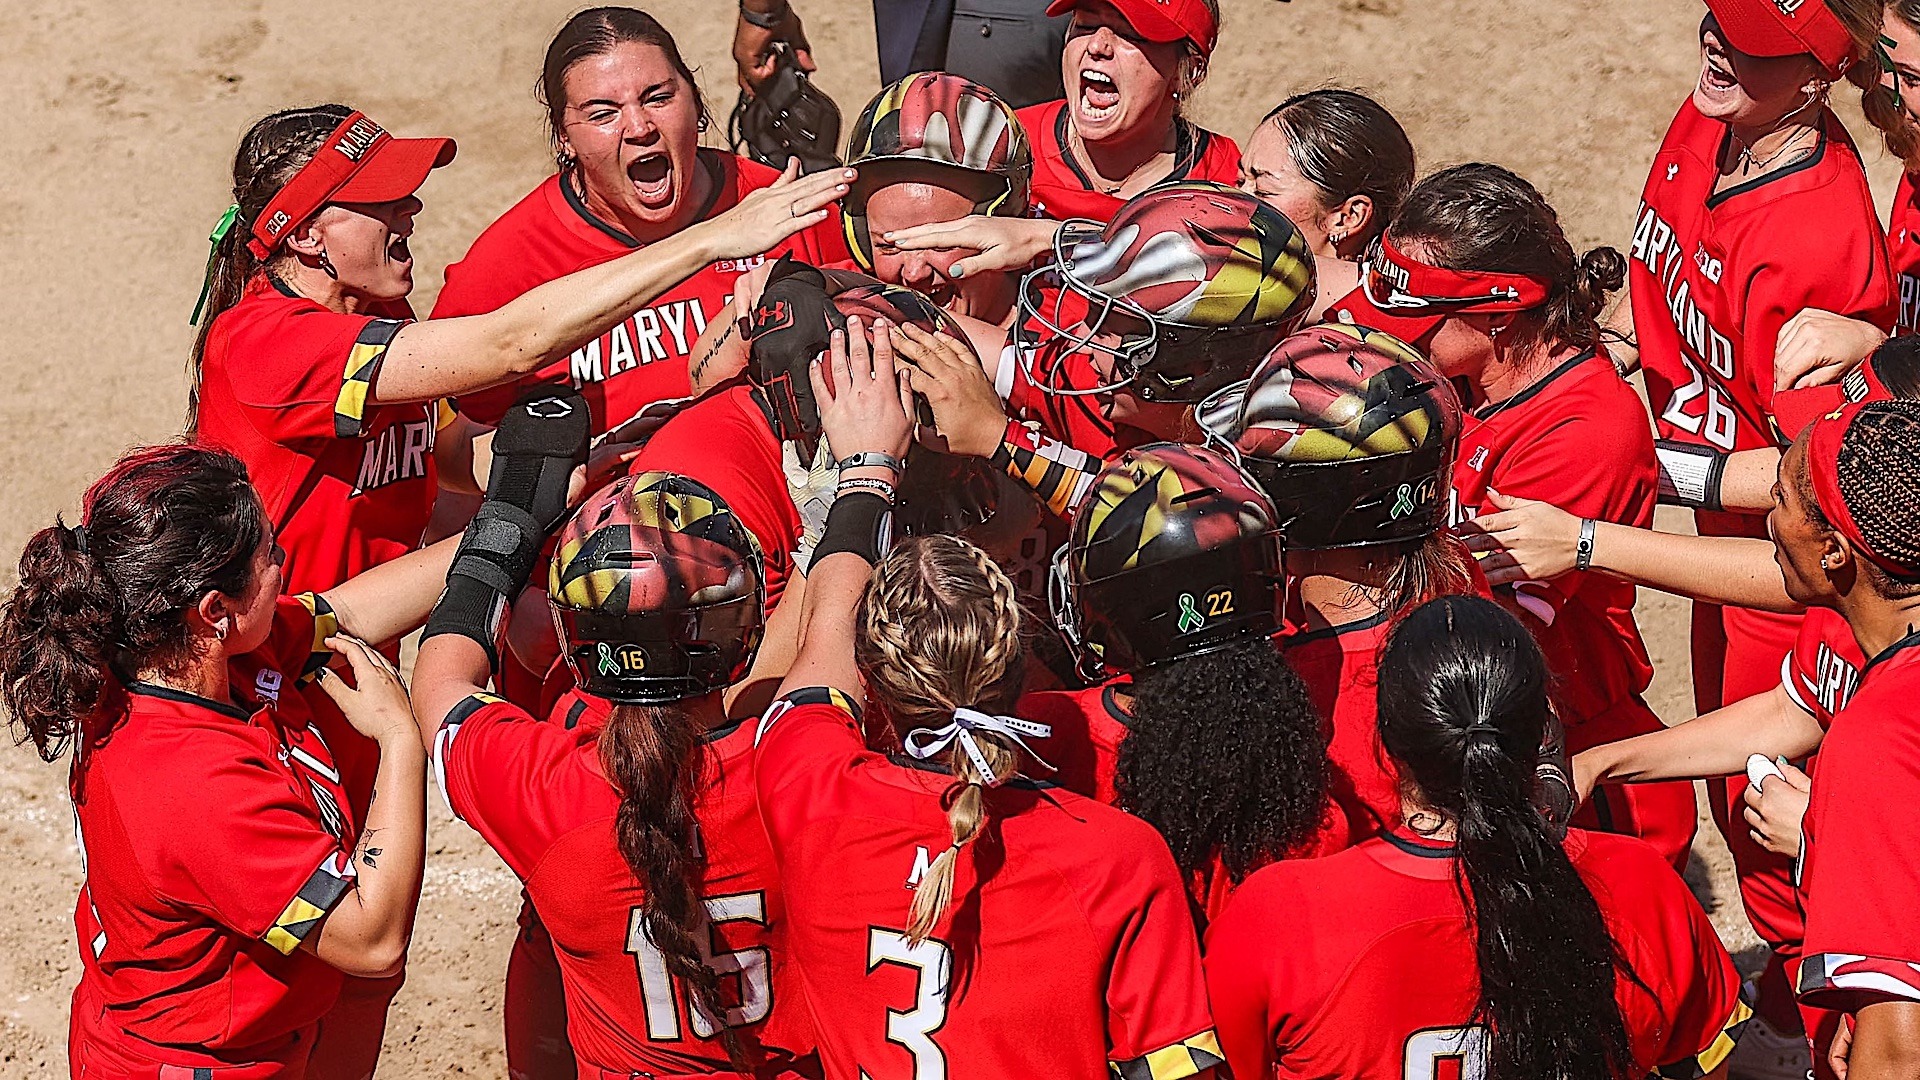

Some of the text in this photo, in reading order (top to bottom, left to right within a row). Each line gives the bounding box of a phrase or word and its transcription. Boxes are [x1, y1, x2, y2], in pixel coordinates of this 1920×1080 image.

[1630, 201, 1734, 380] ARYLAND
[1662, 351, 1737, 450] 26
[1421, 481, 1436, 504] 14
[1207, 591, 1234, 616] 22
[619, 650, 645, 670] 16
[862, 926, 952, 1080] 3
